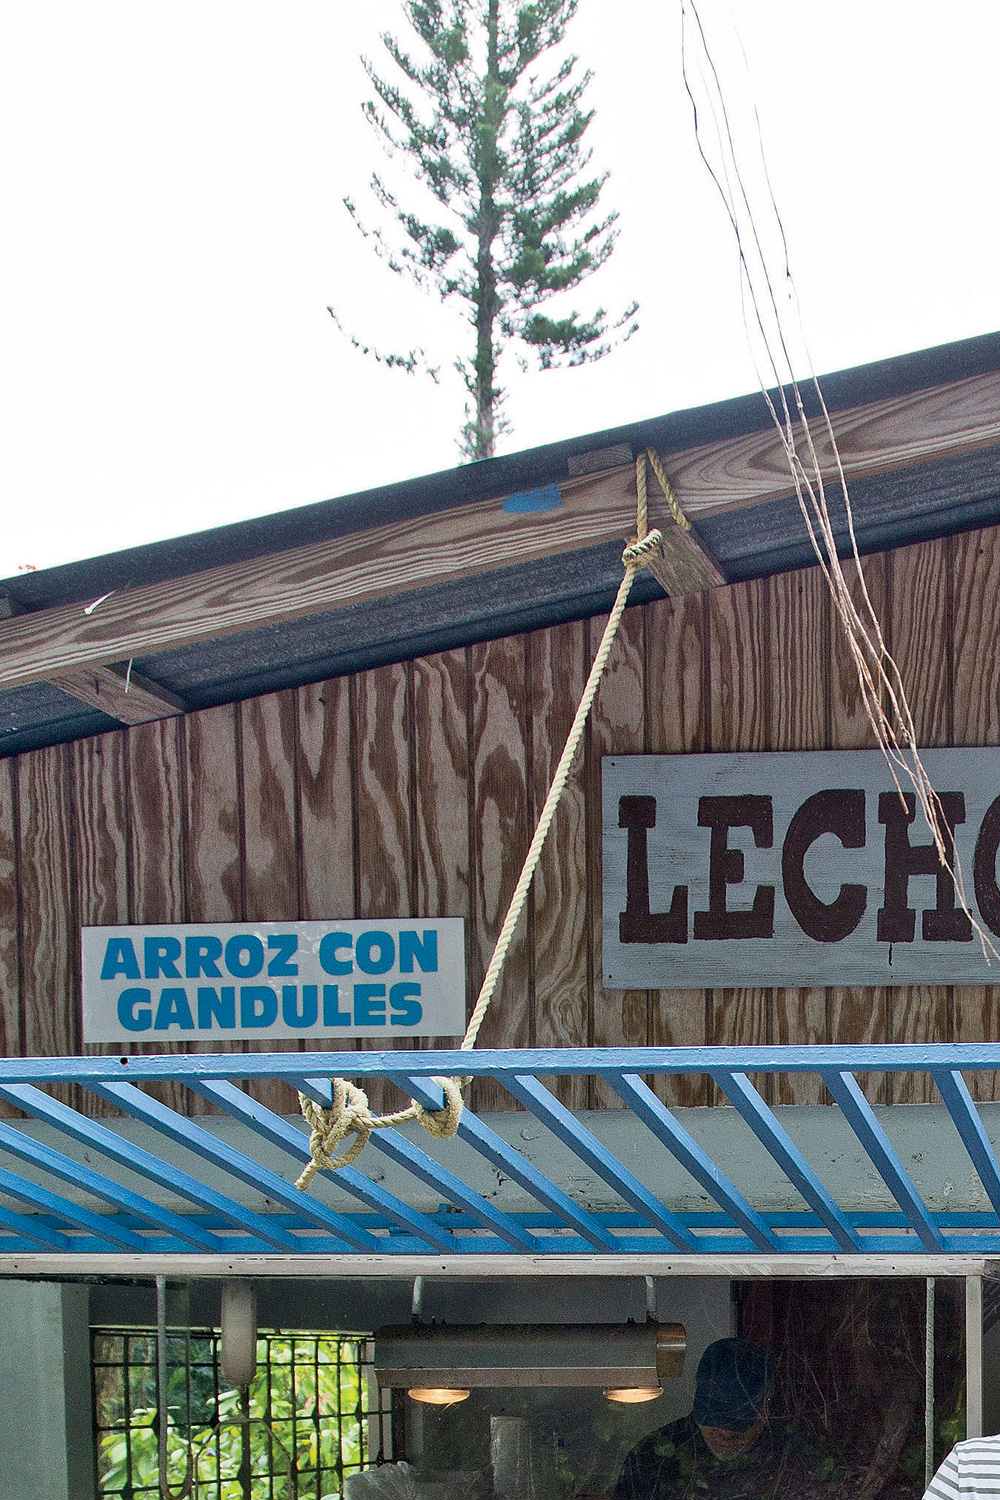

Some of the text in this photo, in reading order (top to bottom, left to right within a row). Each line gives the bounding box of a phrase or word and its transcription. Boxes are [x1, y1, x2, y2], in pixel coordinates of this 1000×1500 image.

[100, 929, 438, 980] ARROZ CON
[117, 981, 423, 1032] GANDULES
